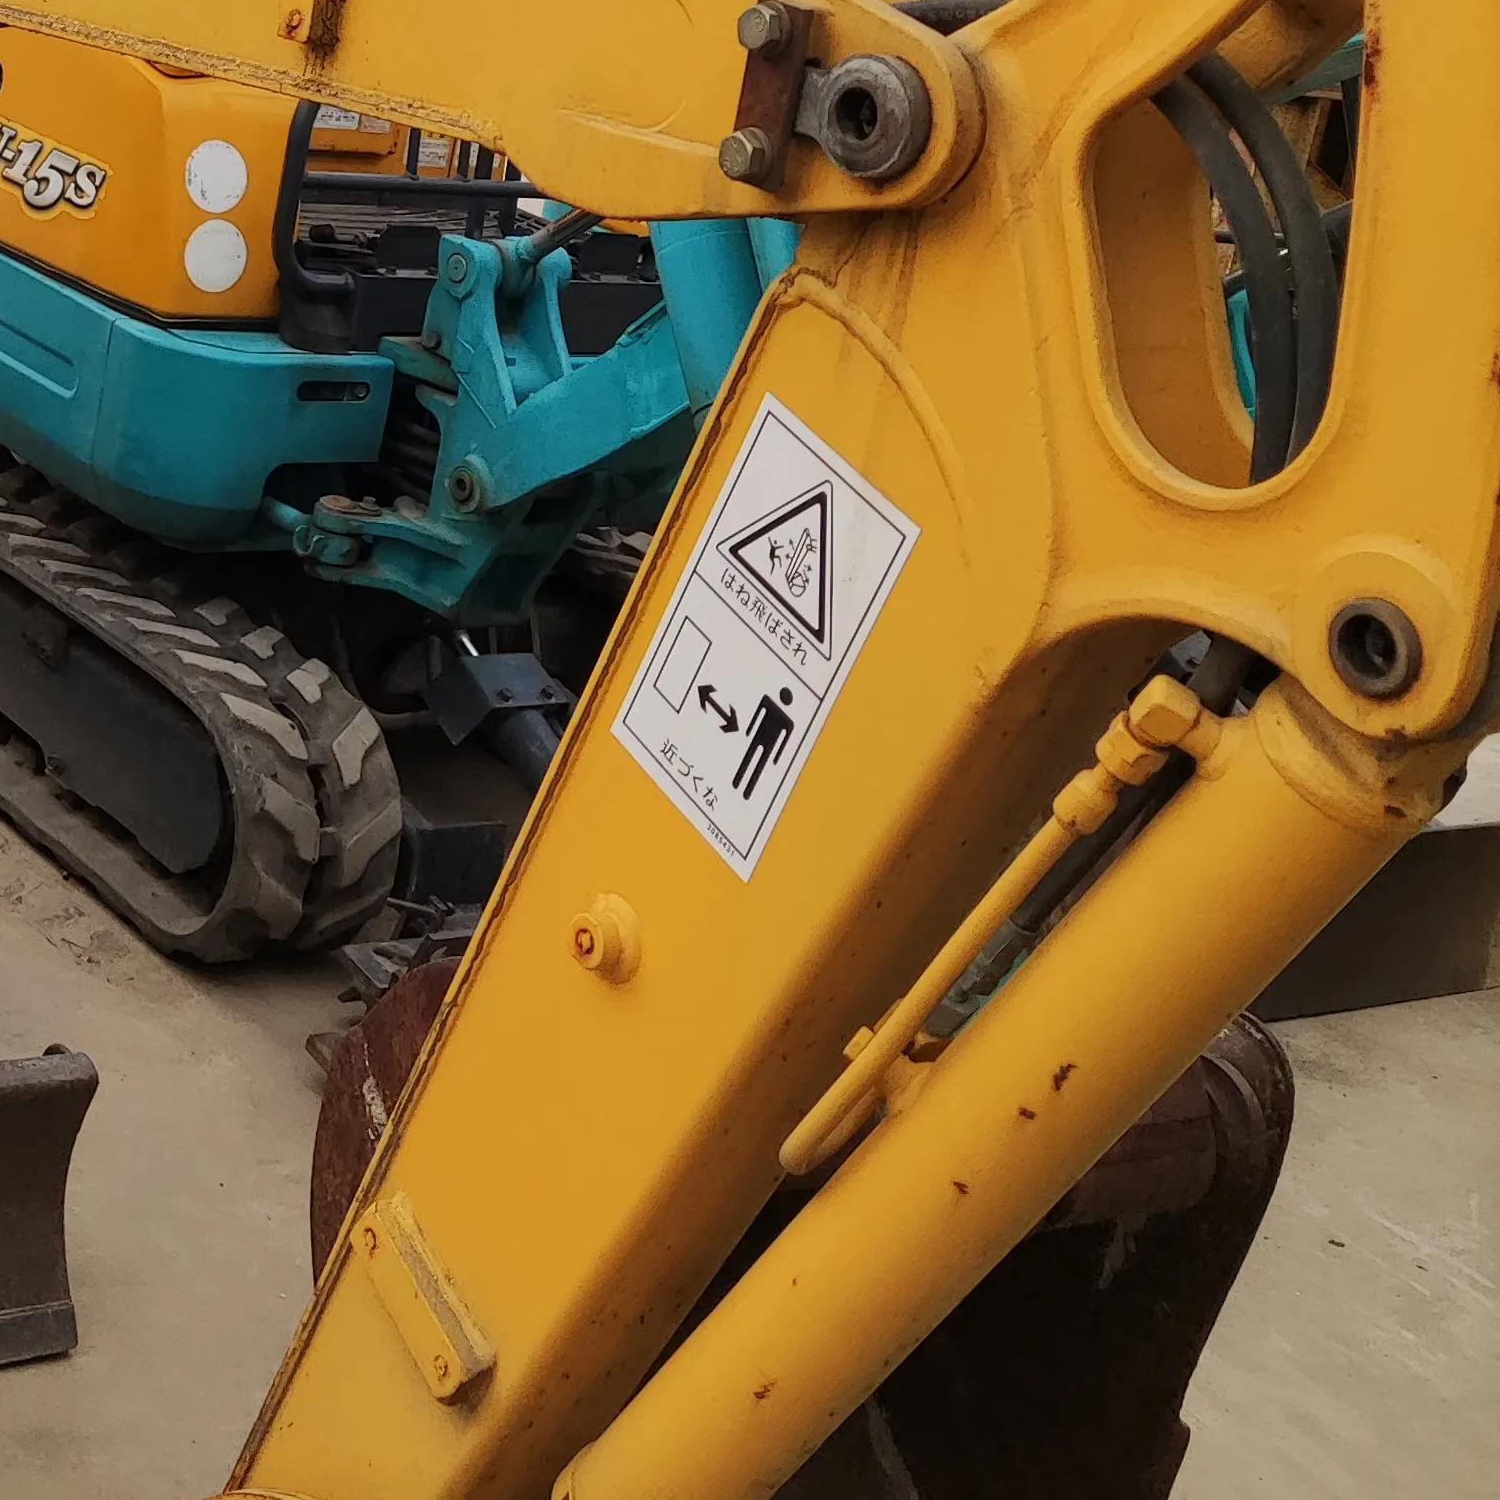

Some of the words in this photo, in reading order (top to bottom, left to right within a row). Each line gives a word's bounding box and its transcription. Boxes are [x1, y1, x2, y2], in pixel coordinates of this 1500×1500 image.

[720, 567, 808, 666] はね飛ばされ
[659, 738, 719, 812] 近づくな
